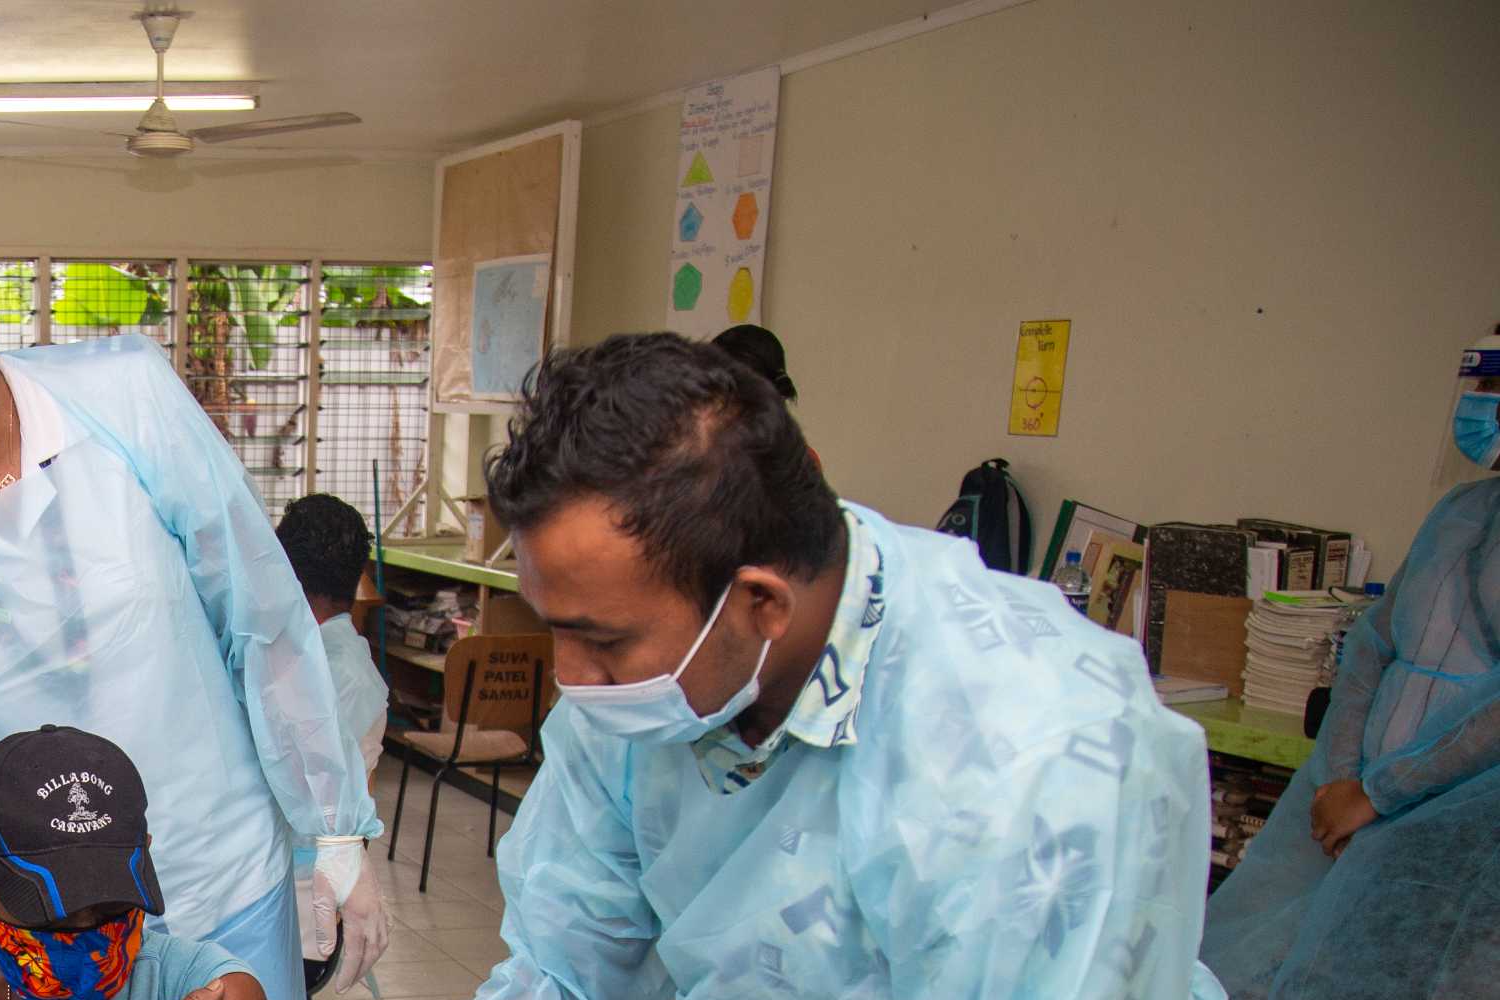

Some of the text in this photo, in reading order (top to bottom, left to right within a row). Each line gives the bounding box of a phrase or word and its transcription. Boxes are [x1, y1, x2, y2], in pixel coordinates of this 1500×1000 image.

[489, 652, 529, 664] SUVA
[484, 671, 526, 683] PATEL
[478, 688, 529, 701] SAMAJ
[36, 771, 113, 800] BILLABONG
[50, 813, 112, 833] CARAVANS
